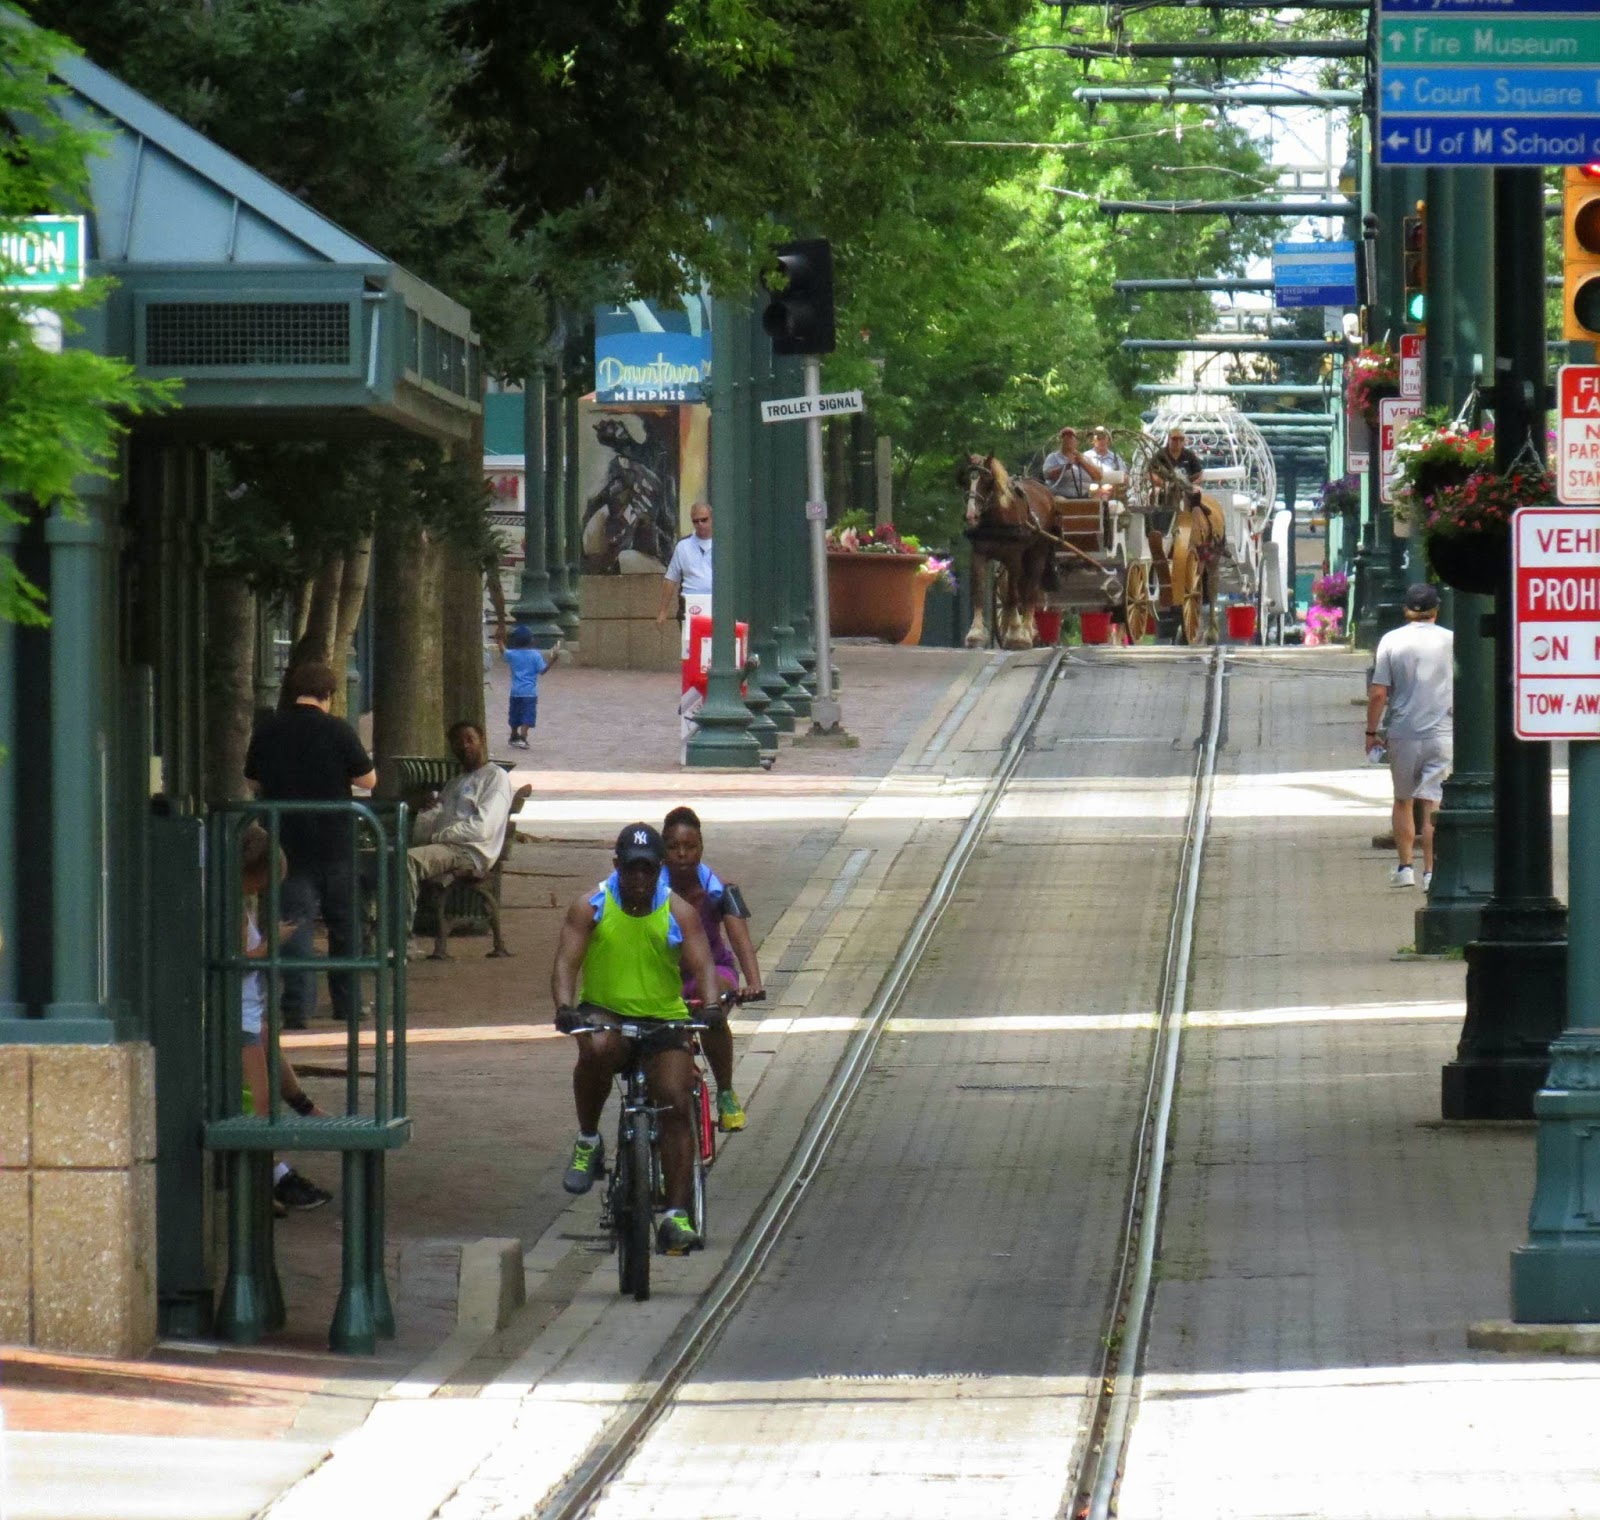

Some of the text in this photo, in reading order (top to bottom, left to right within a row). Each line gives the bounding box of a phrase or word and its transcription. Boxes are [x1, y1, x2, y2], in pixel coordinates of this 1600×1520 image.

[1414, 27, 1578, 55] Fire Museum
[1414, 76, 1481, 104] Court
[1495, 77, 1583, 109] Square
[1414, 127, 1432, 155] U
[1438, 131, 1465, 154] of
[1473, 127, 1493, 154] M
[1502, 127, 1585, 155] School
[599, 352, 699, 388] Downtown
[614, 390, 686, 401] MEMPHIS
[1579, 377, 1599, 394] FI
[767, 397, 858, 417] TROLLEY SIGNAL
[1529, 578, 1600, 611] PROH
[1527, 693, 1600, 715] TOW-AW
